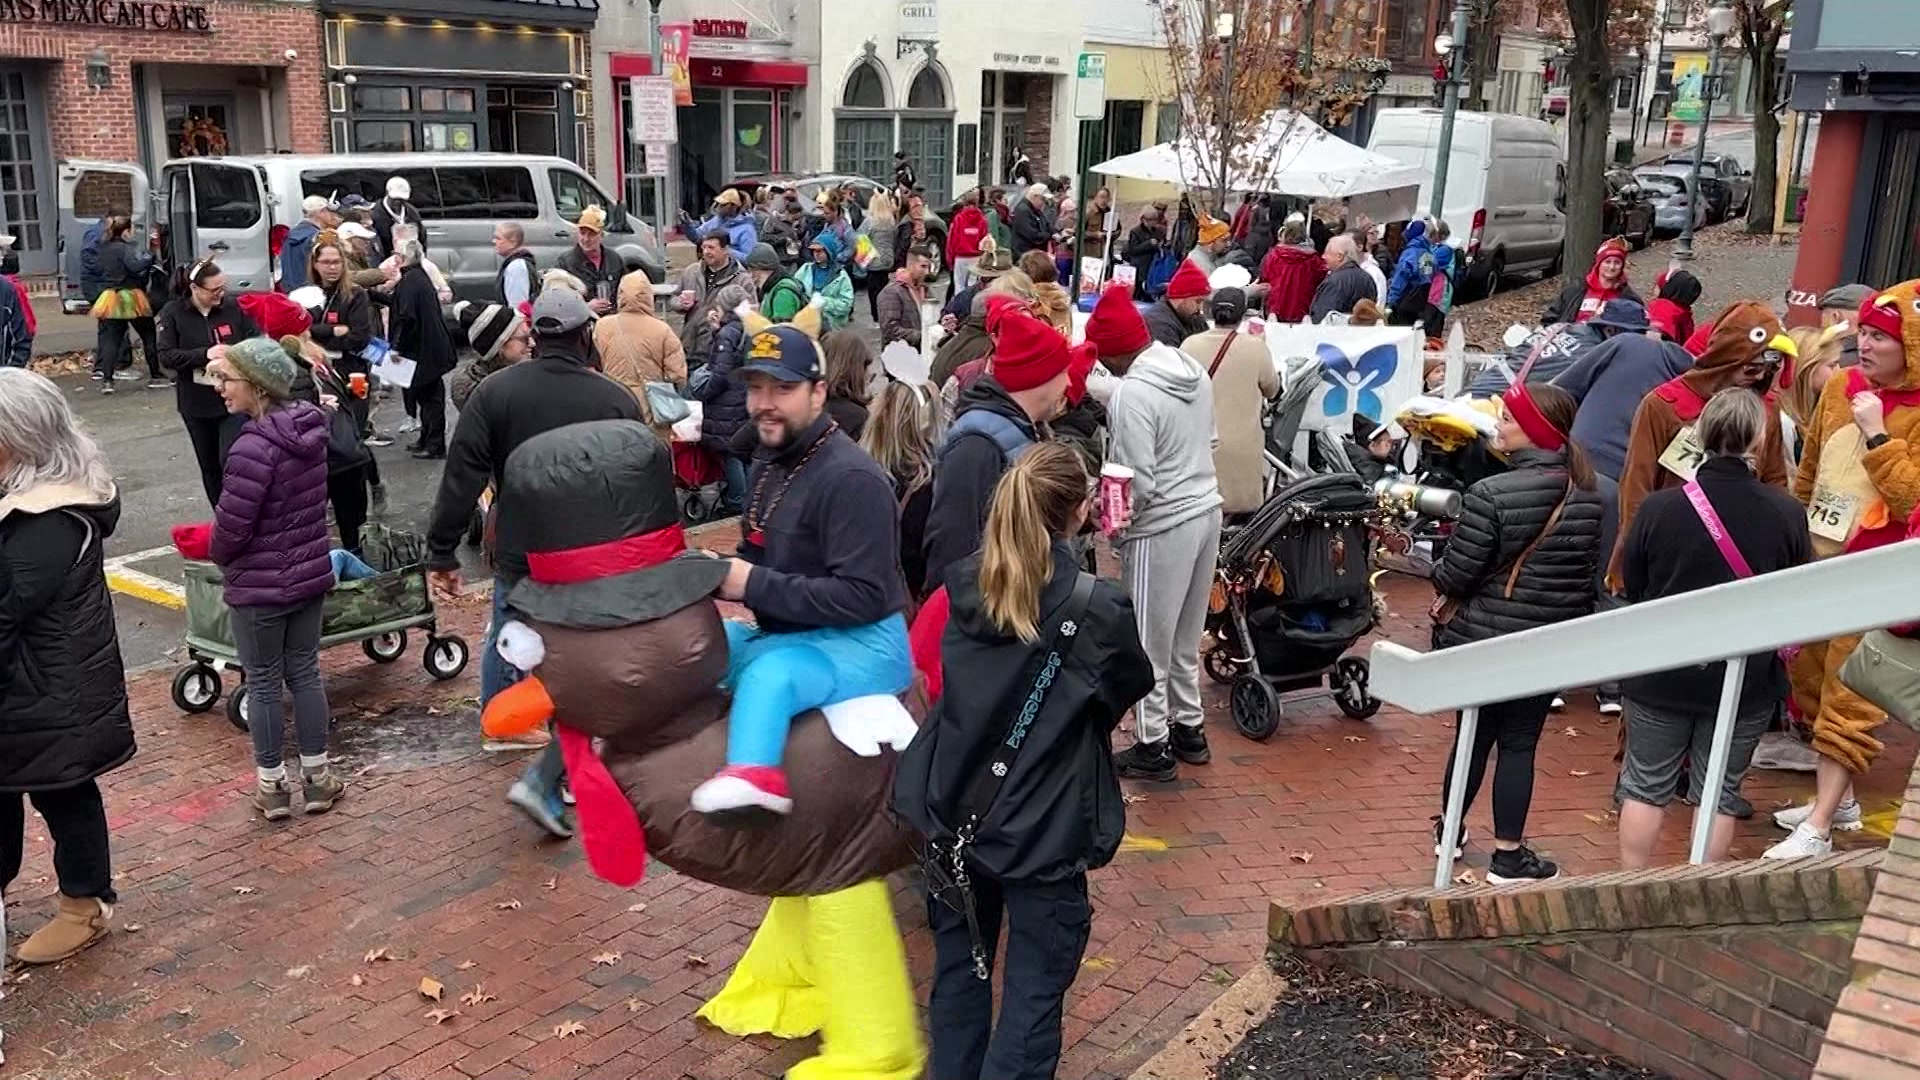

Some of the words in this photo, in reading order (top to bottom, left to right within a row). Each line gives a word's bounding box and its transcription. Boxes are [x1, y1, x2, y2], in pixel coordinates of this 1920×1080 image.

[41, 0, 146, 29] MEXICAN
[151, 3, 210, 31] CAFE
[902, 7, 936, 18] GRILL
[711, 65, 723, 77] 22
[1810, 505, 1841, 526] 715
